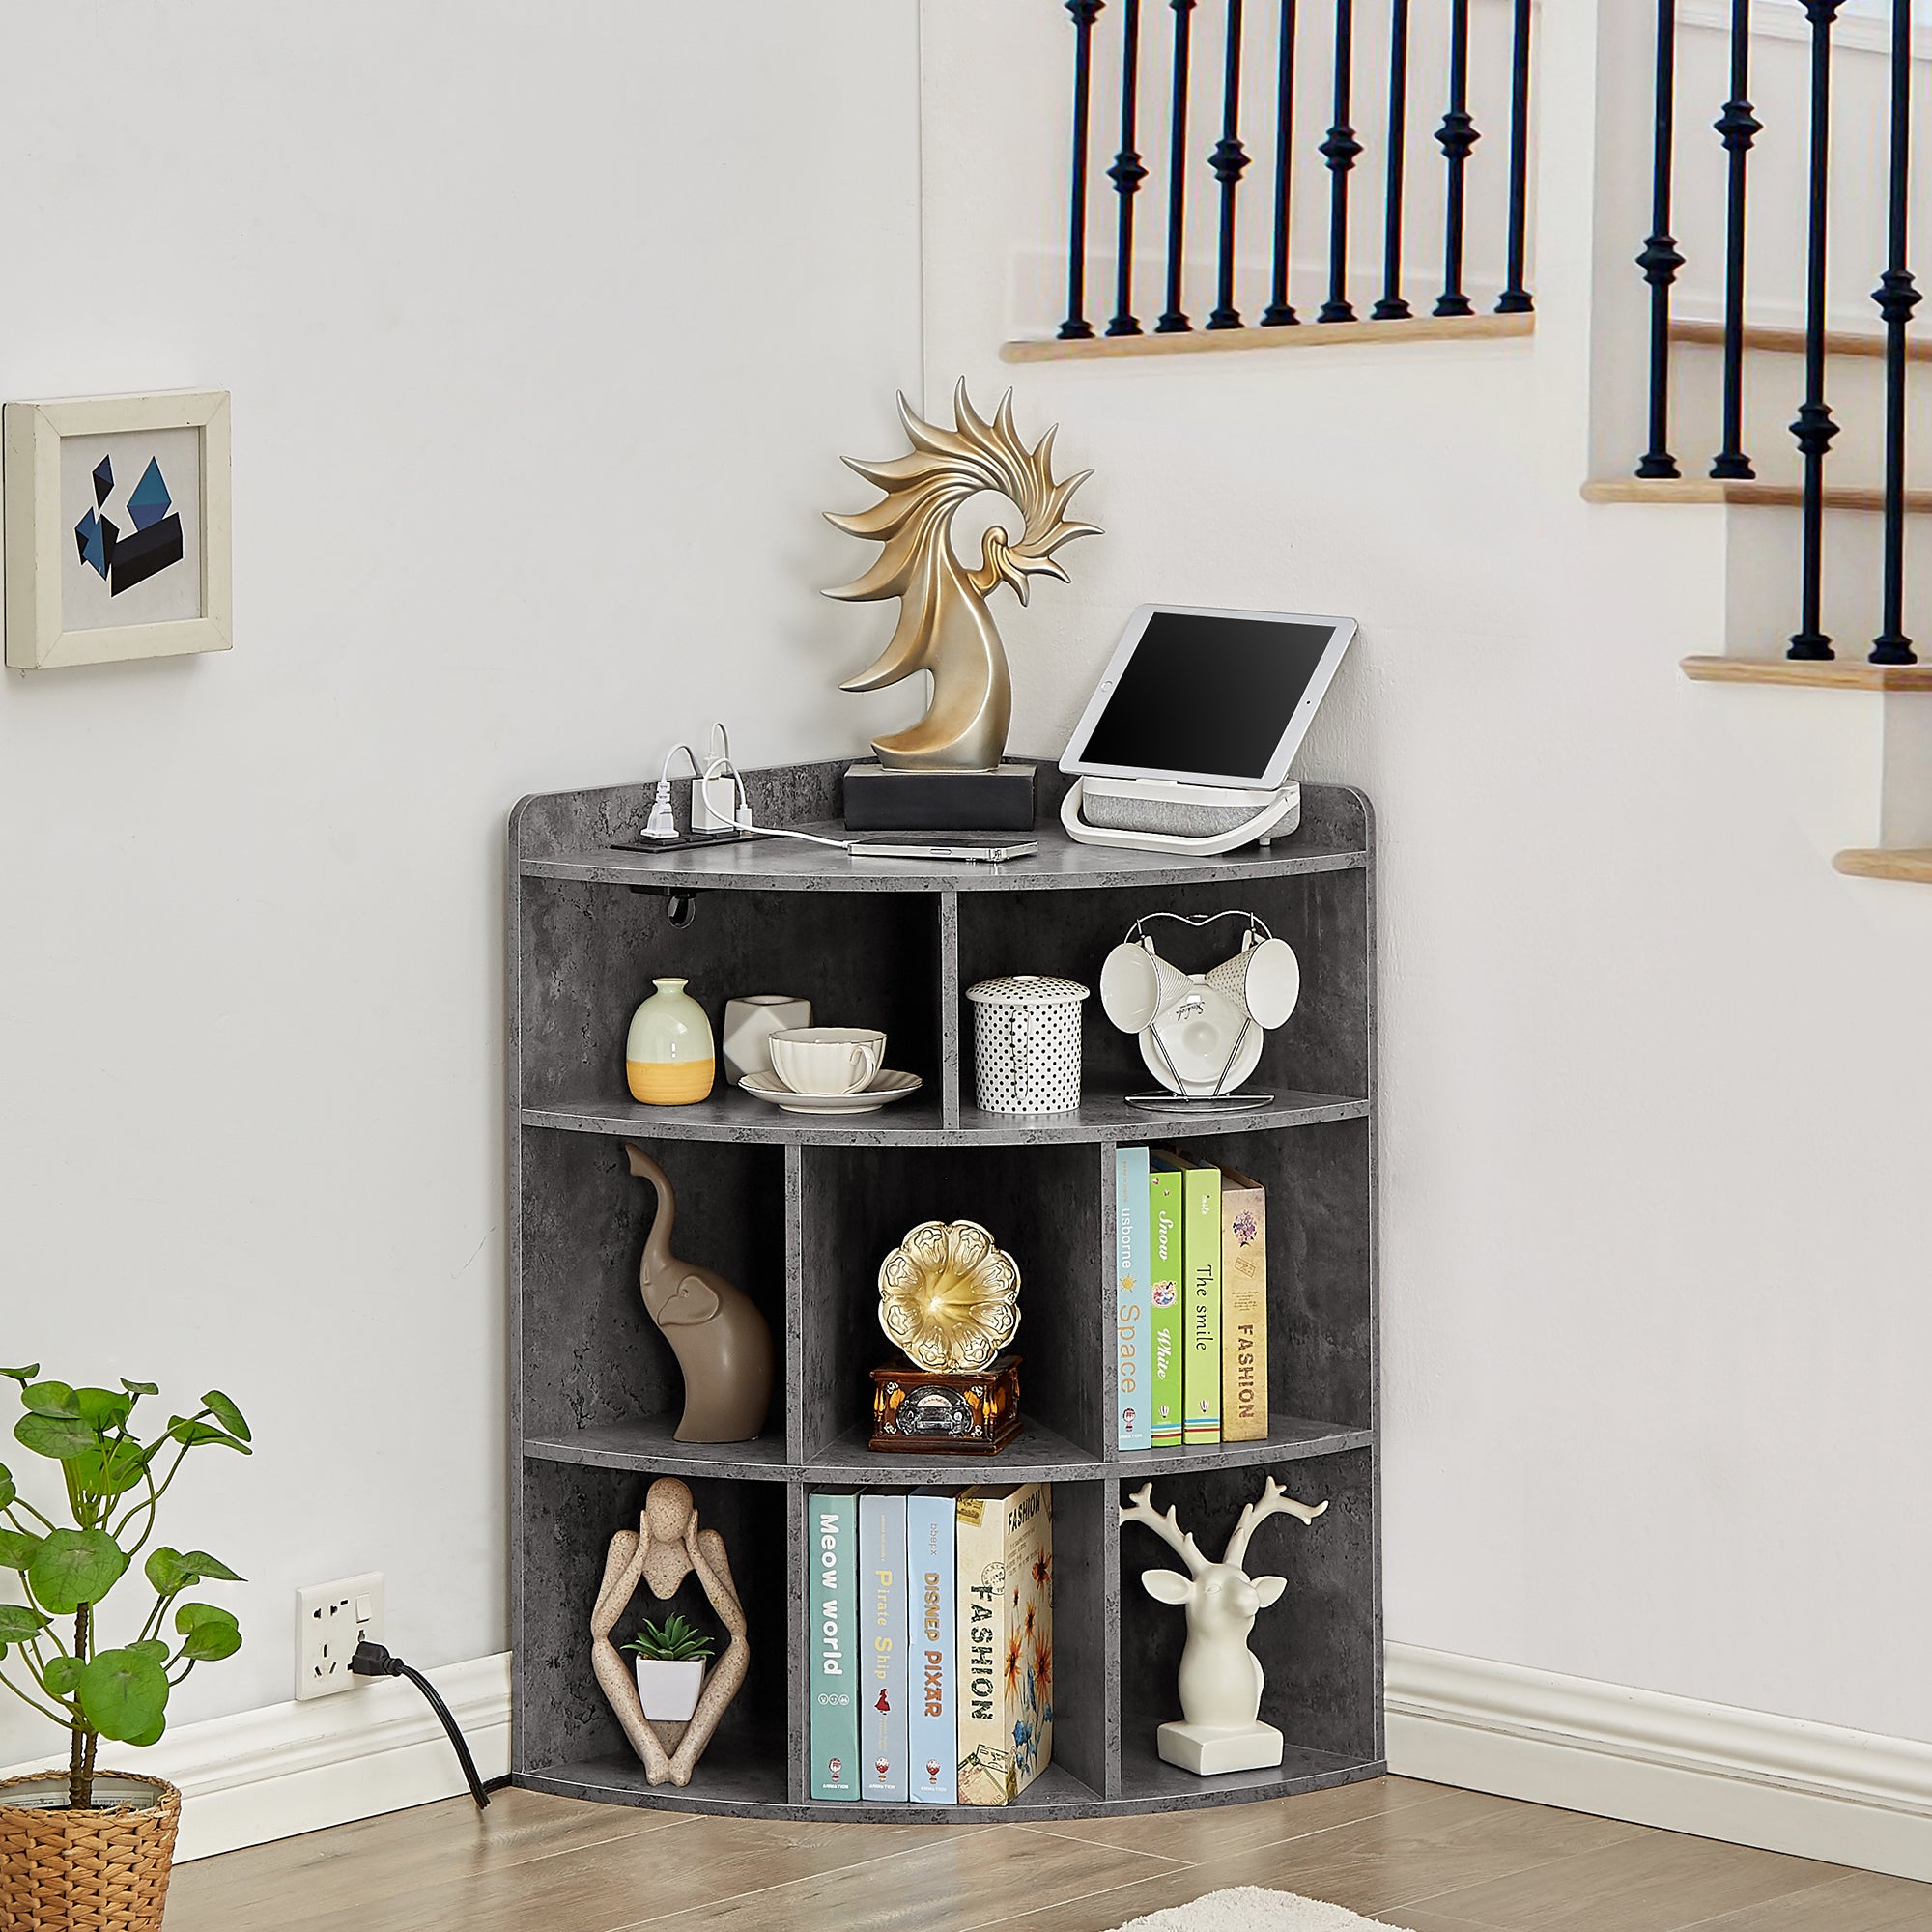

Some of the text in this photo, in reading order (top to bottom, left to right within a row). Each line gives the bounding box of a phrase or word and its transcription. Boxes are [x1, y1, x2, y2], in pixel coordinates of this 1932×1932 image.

[1121, 1208, 1132, 1269] usborne
[1157, 1210, 1174, 1380] Snow White
[1196, 1264, 1214, 1350] The smile
[1119, 1305, 1141, 1393] Space
[1238, 1324, 1255, 1418] FASHION
[1008, 1489, 1041, 1536] FASHION
[820, 1514, 843, 1675] Meow world
[875, 1570, 893, 1680] Pirate Ship
[924, 1651, 943, 1718] PIXAR
[971, 1585, 994, 1720] FASHION
